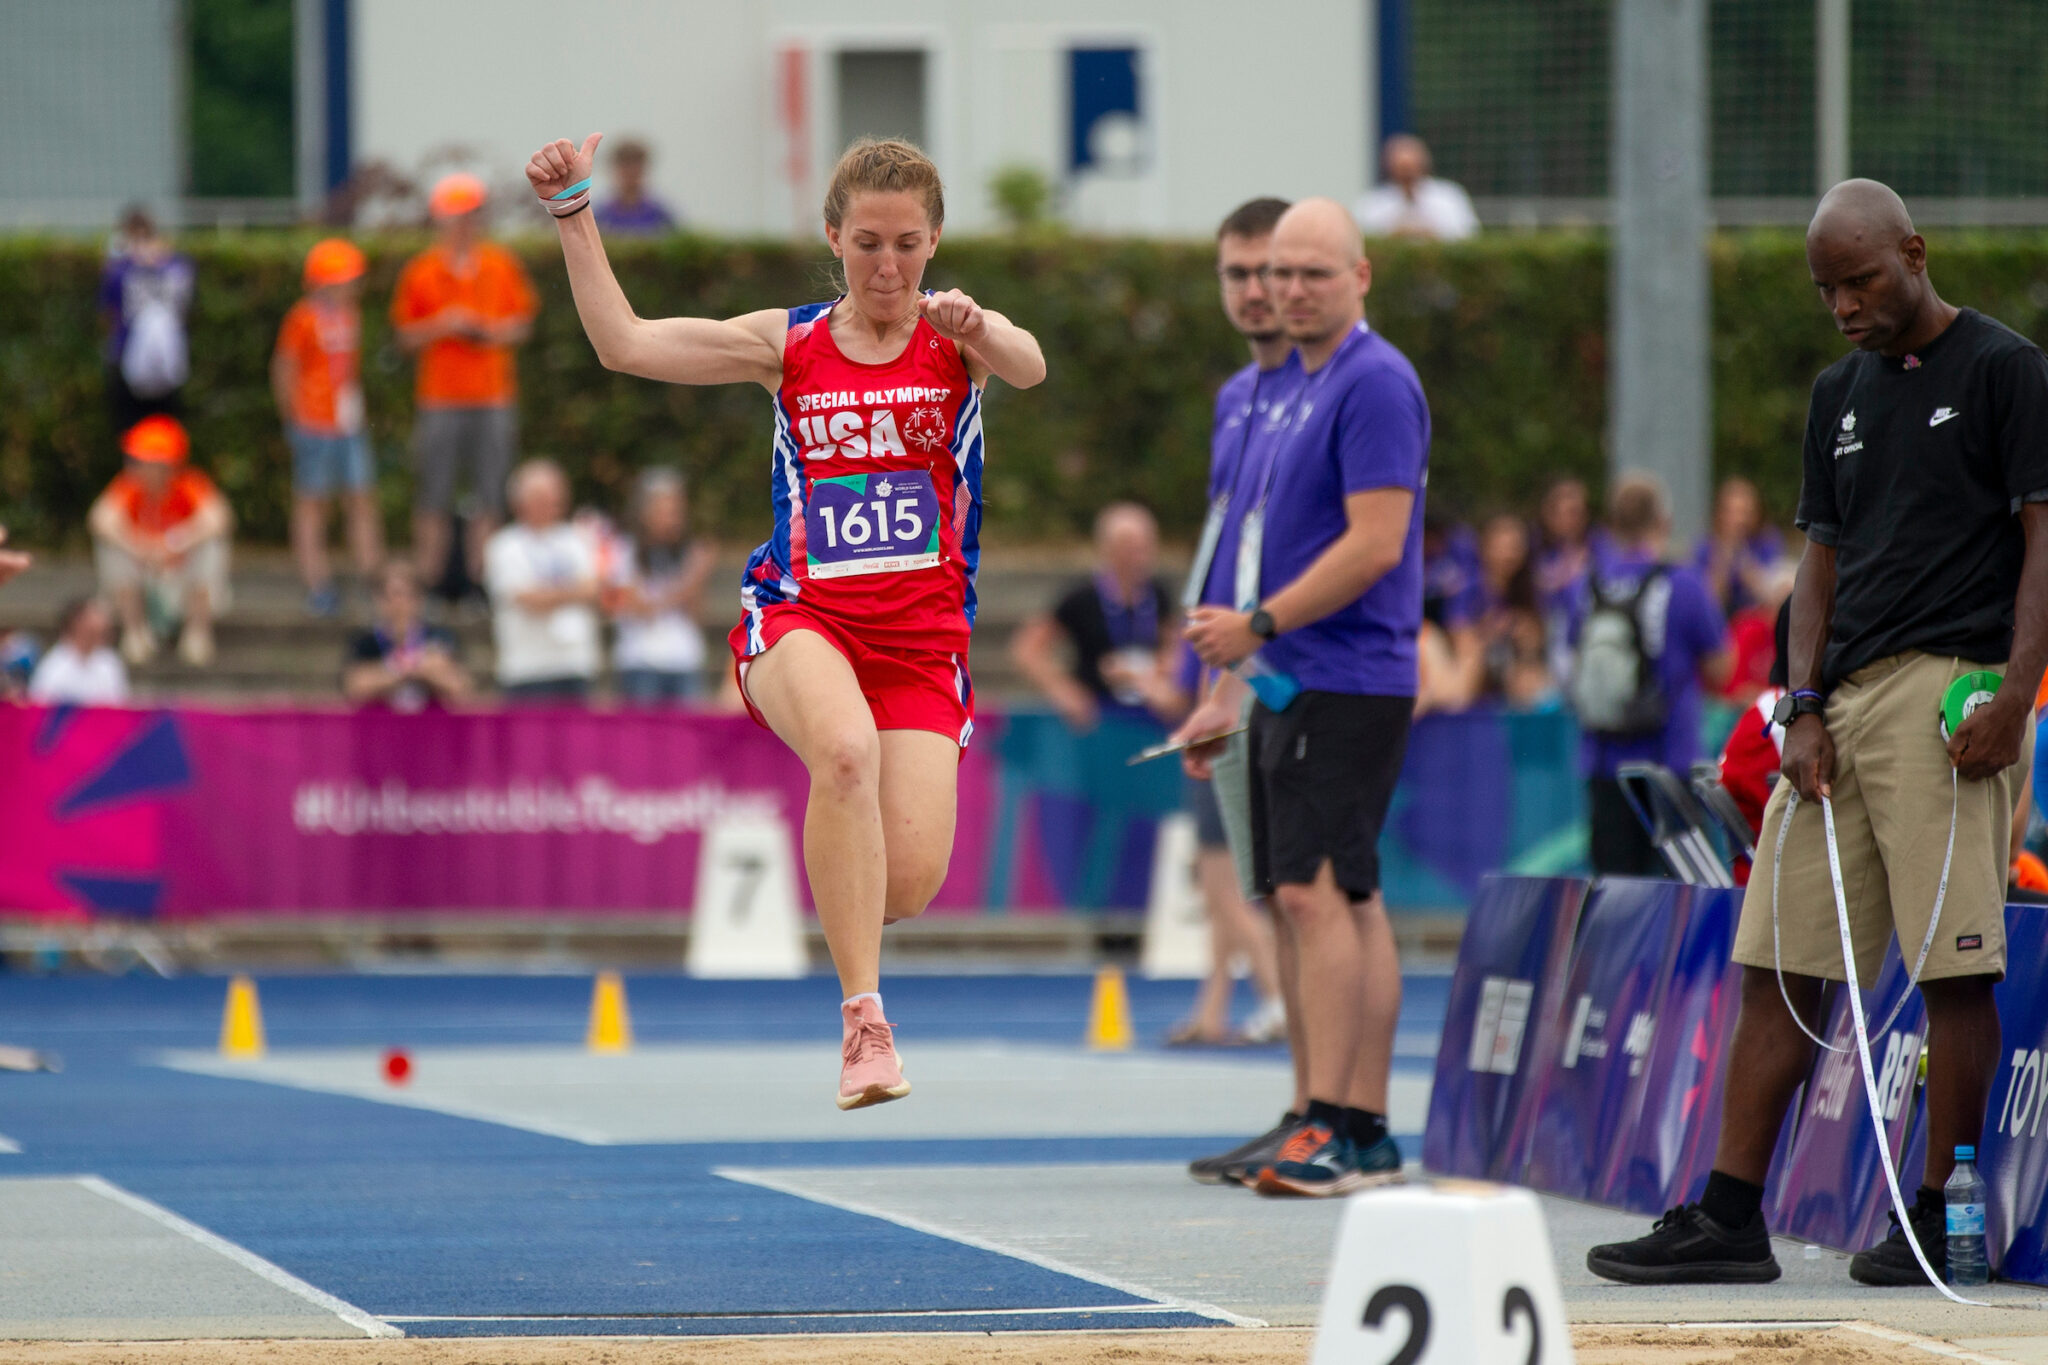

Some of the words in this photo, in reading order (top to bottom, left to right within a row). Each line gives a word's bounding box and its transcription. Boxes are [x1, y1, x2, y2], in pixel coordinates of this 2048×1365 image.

[797, 391, 860, 412] SPECIAL
[863, 387, 951, 406] OLYMPICS
[798, 409, 908, 461] USA
[819, 498, 923, 548] 1615
[727, 852, 770, 929] 7
[1998, 1048, 2048, 1138] TOY
[1362, 1283, 1432, 1365] 2
[1502, 1286, 1542, 1365] 2
